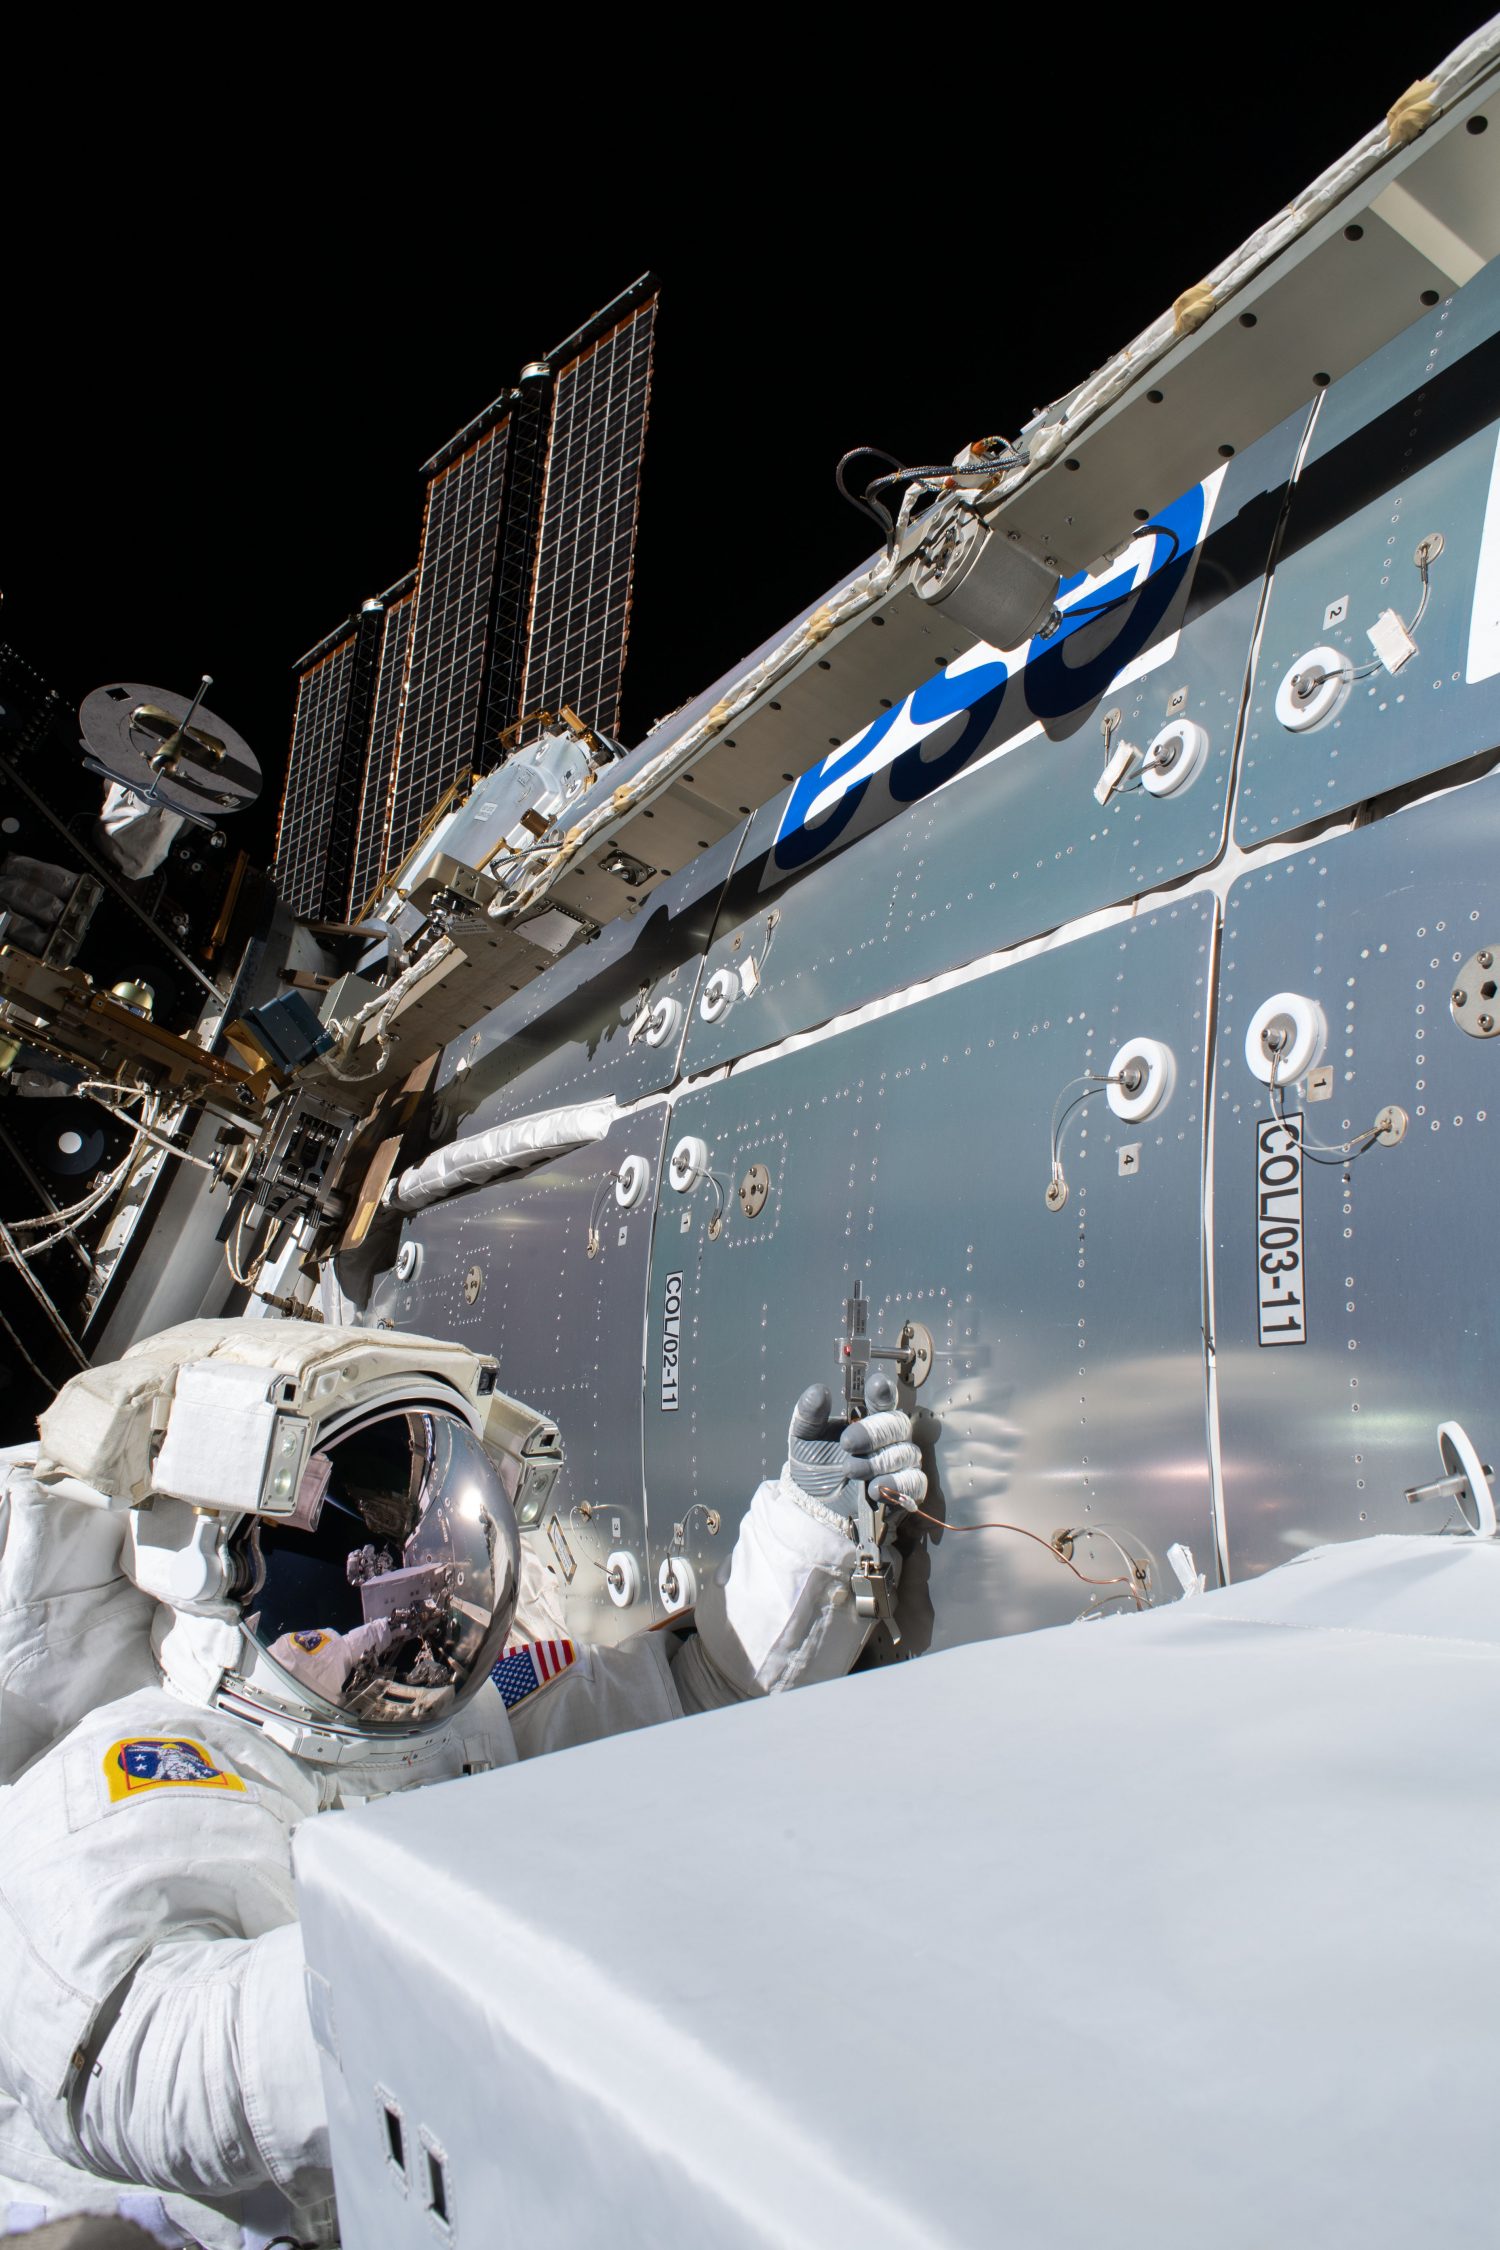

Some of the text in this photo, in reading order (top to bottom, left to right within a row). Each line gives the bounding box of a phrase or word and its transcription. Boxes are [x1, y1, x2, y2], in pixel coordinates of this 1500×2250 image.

[1330, 605, 1342, 618] 2
[1172, 694, 1183, 707] 3
[1314, 1078, 1327, 1090] 1
[1123, 1154, 1134, 1166] 4
[1259, 1123, 1302, 1333] COL/03-11
[662, 1276, 682, 1403] COL/02-11
